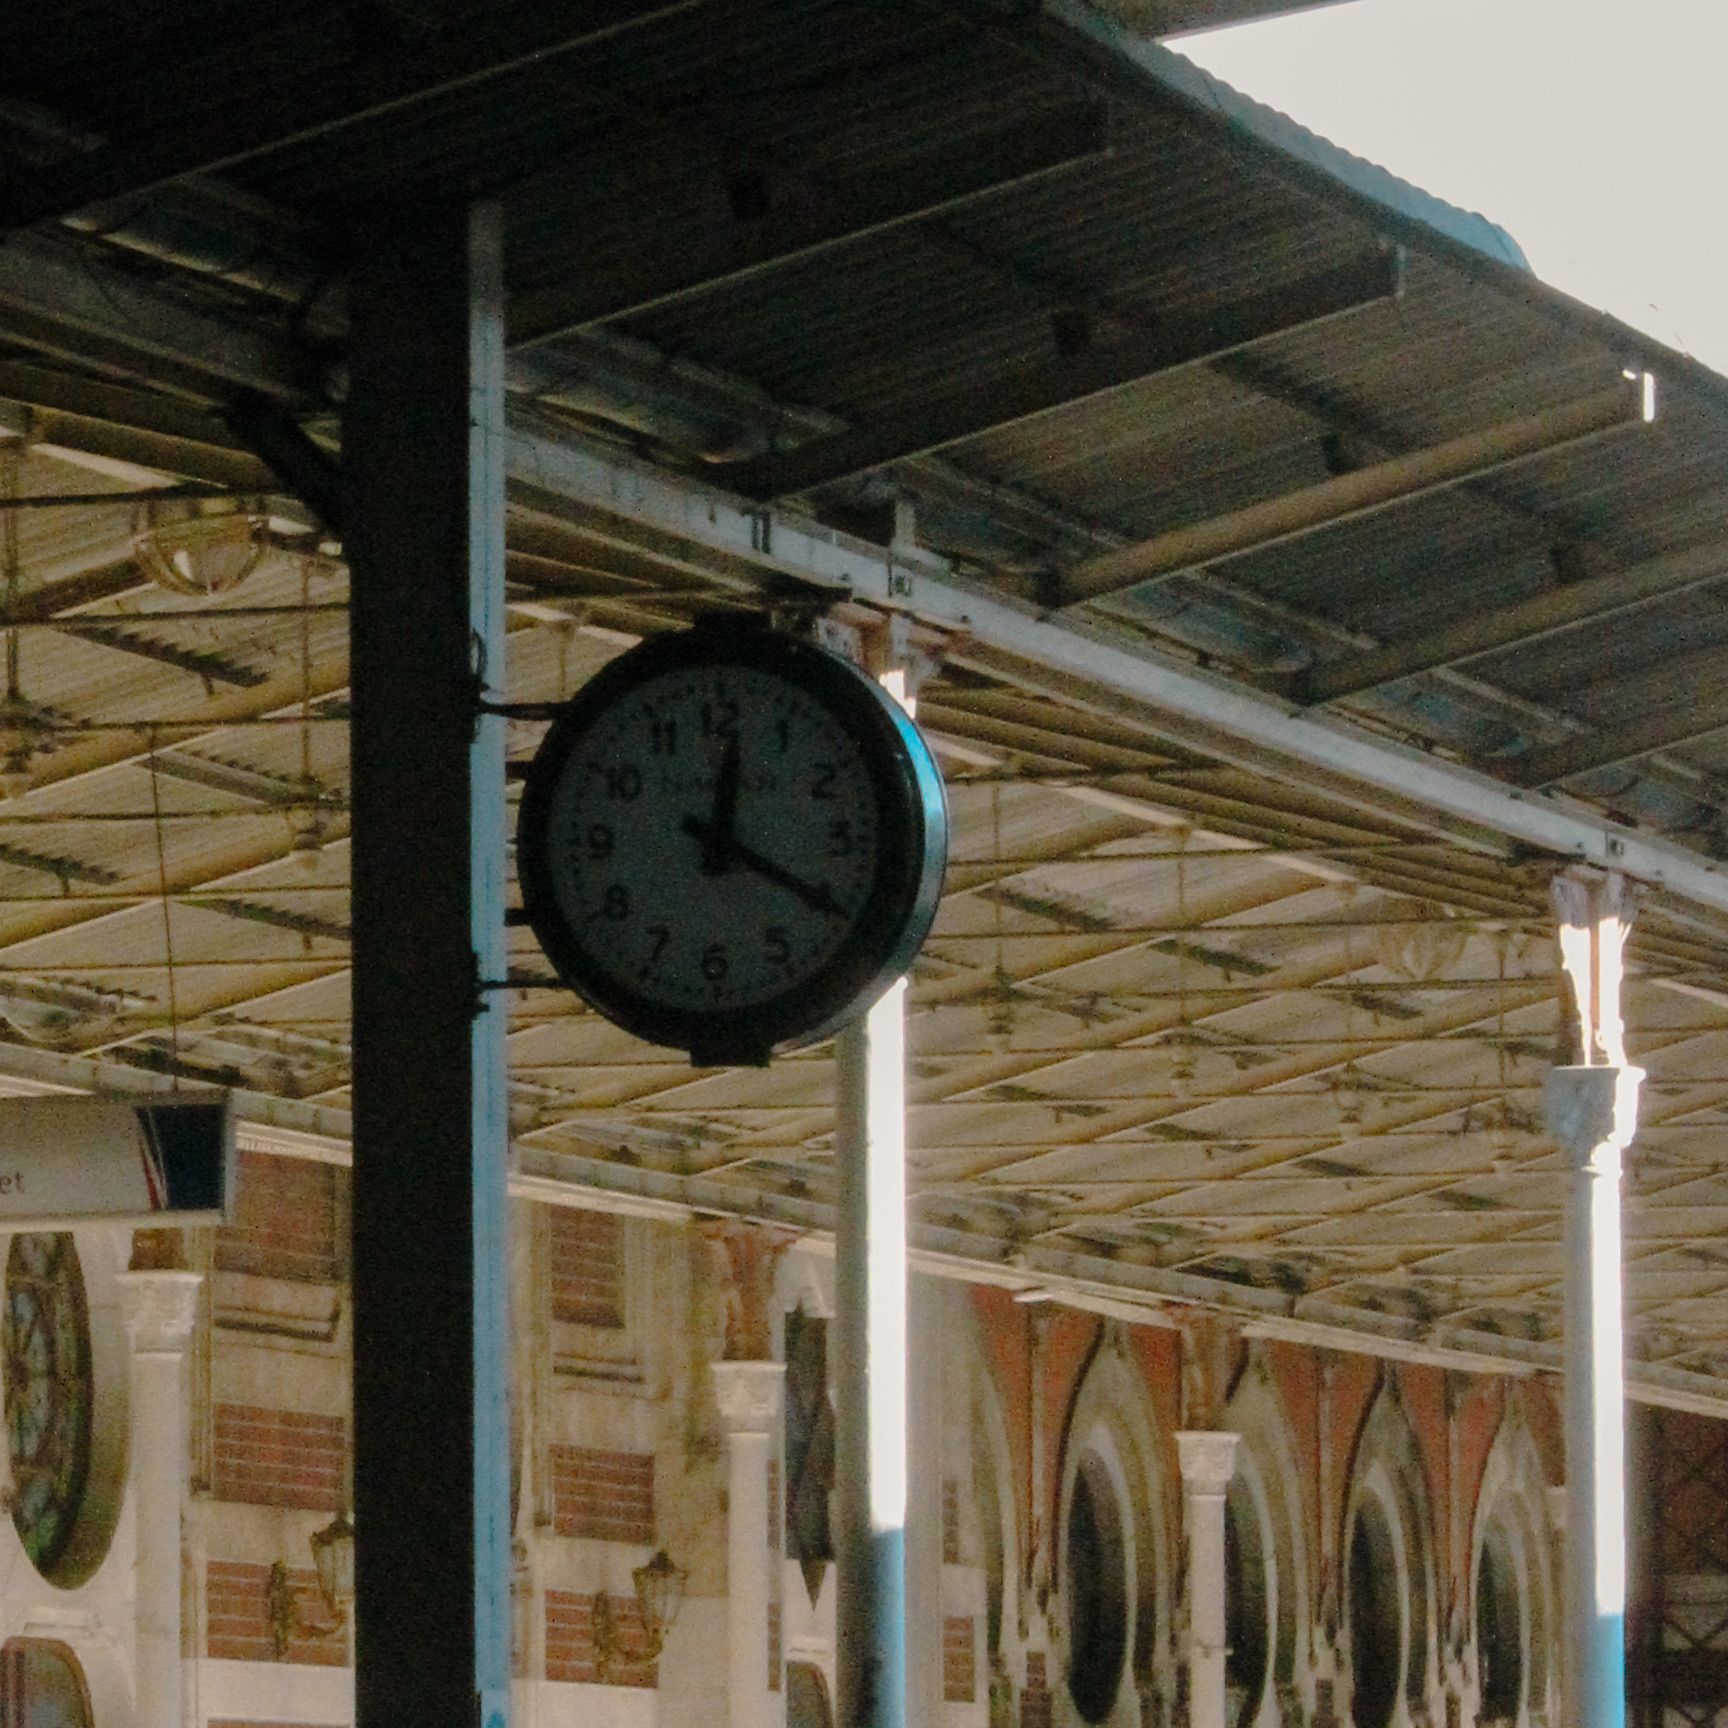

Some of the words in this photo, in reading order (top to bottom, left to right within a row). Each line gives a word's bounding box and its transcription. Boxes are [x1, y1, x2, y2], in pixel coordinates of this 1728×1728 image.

[702, 702, 740, 737] 12
[778, 721, 790, 753] 1
[652, 722, 676, 754] 11
[609, 765, 642, 802] 10
[812, 762, 836, 799] 2
[589, 824, 614, 859] 9
[829, 820, 851, 855] 3
[605, 885, 630, 920] 8
[647, 926, 669, 962] 7
[764, 926, 790, 963] 5
[703, 945, 728, 981] 6
